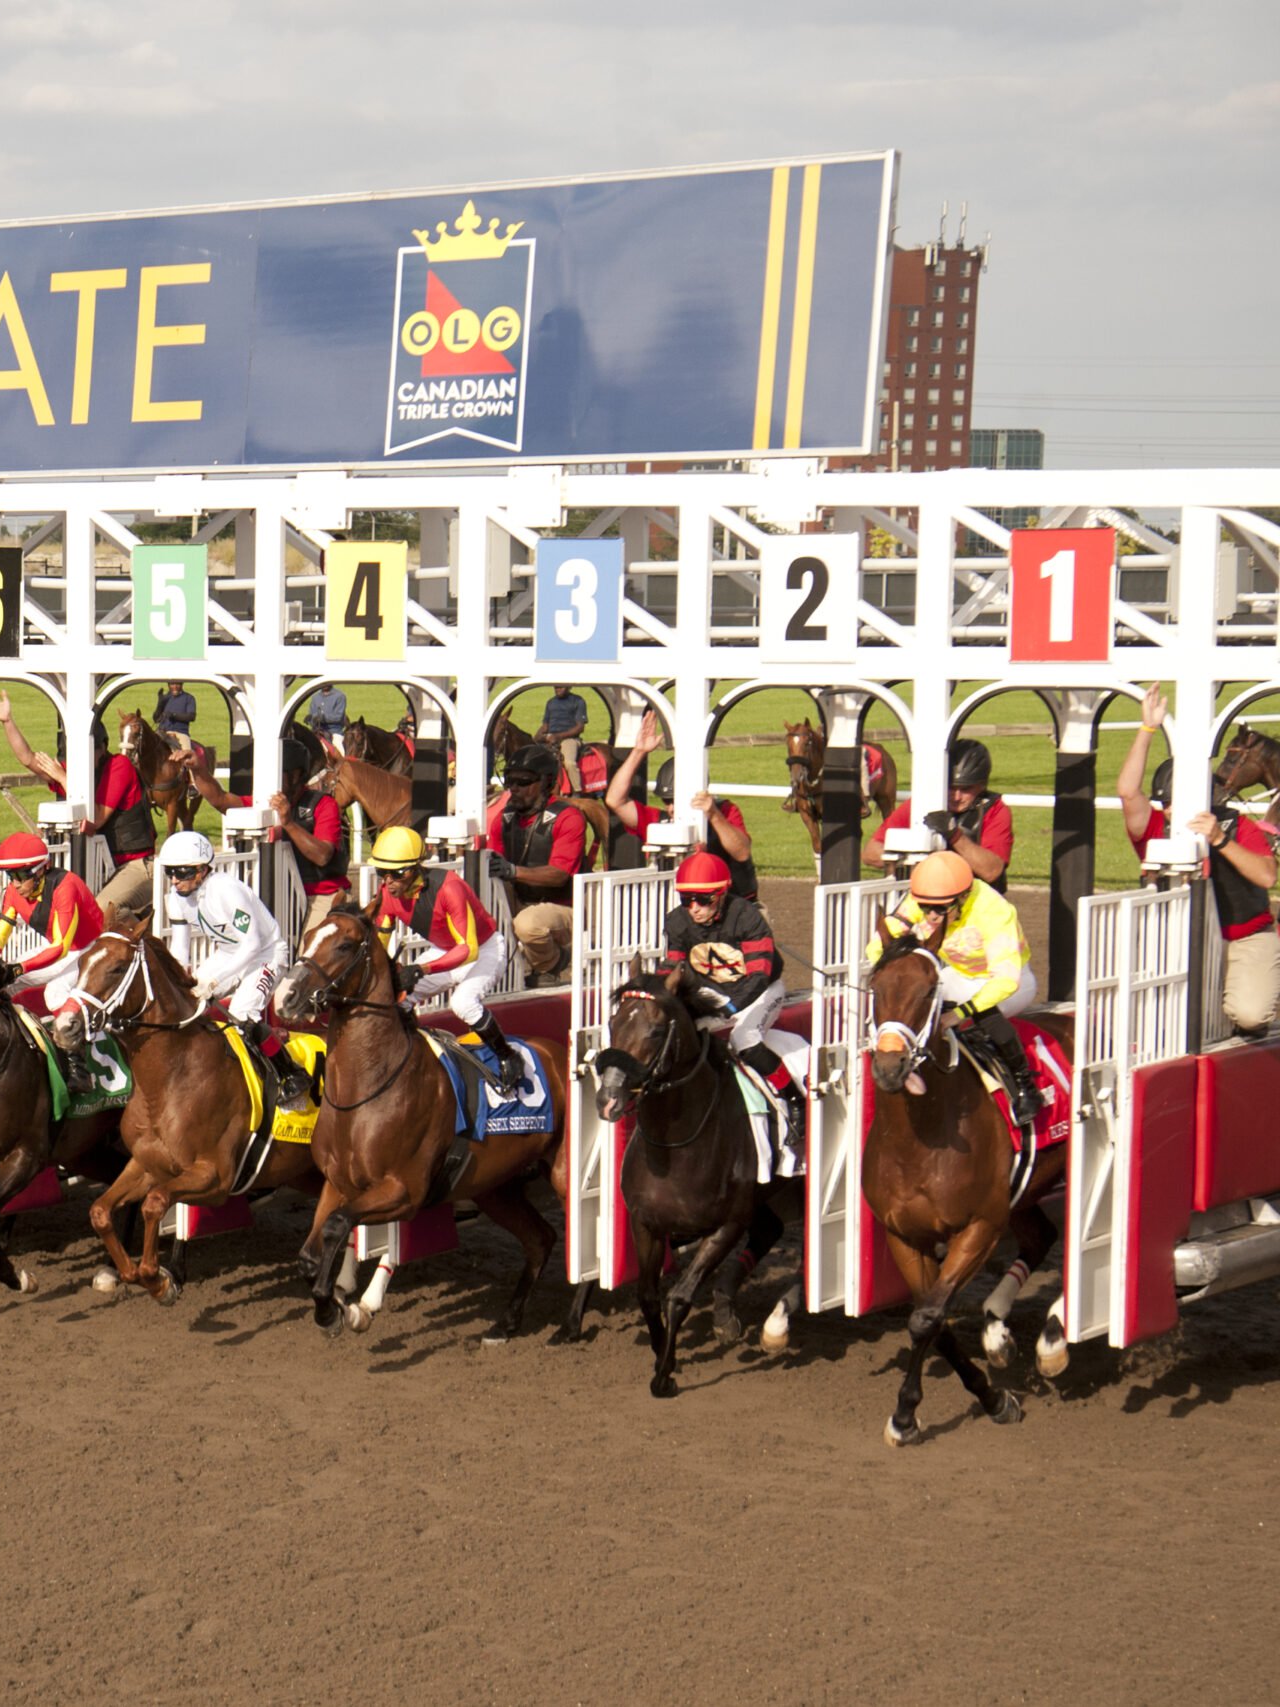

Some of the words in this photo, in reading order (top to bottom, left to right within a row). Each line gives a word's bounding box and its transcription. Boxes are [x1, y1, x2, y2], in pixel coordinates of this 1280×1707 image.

[409, 315, 513, 347] OLG
[398, 378, 517, 402] CANADIAN
[398, 403, 450, 420] TRIPLE
[451, 400, 514, 418] CROWN
[149, 562, 186, 640] 5
[343, 562, 383, 640] 4
[553, 557, 599, 645] 3
[785, 557, 828, 641] 2
[1038, 549, 1076, 643] 1
[234, 914, 250, 928] KC
[89, 1030, 128, 1093] 5
[507, 1041, 547, 1107] 3
[485, 1116, 509, 1133] SSEX
[509, 1114, 547, 1130] SERPENT
